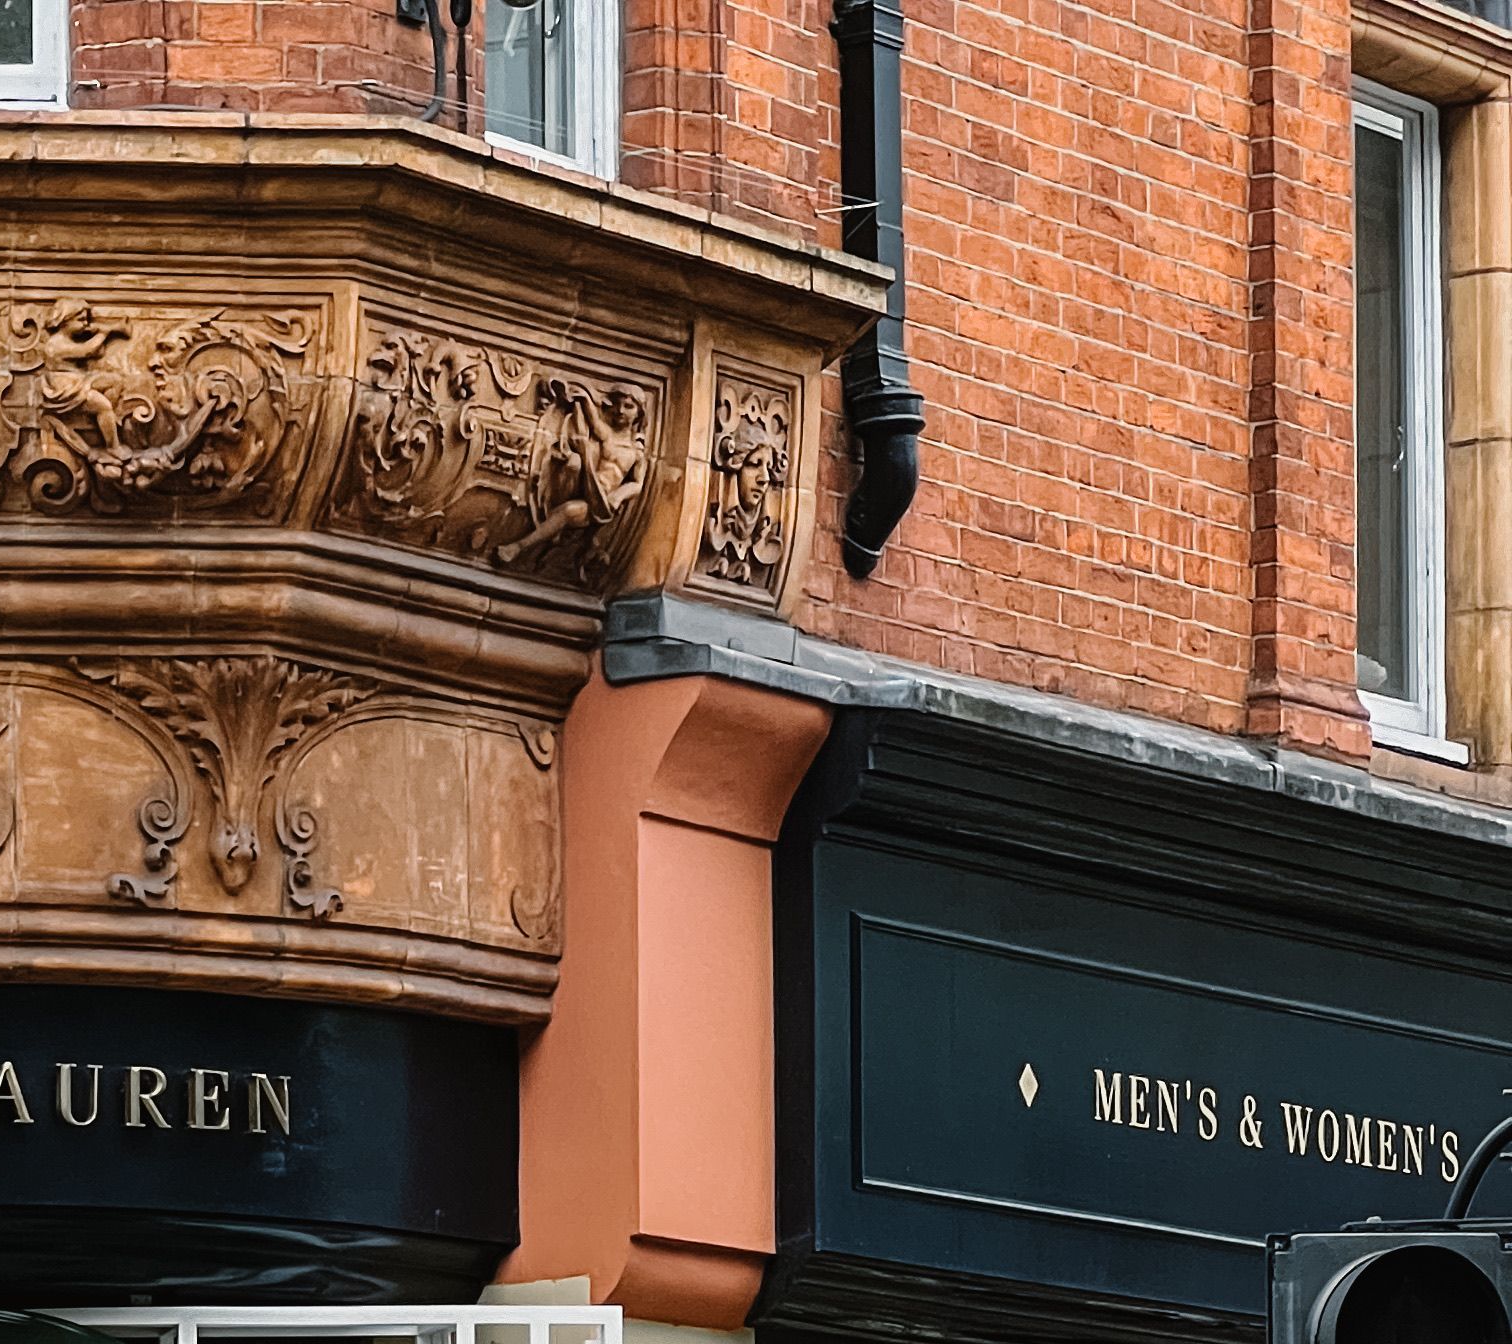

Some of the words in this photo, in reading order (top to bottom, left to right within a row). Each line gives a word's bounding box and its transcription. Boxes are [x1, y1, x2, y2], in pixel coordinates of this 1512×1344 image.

[1093, 1068, 1219, 1142] MEN'S
[1239, 1095, 1264, 1149] &
[1280, 1102, 1461, 1183] WOMEN'S
